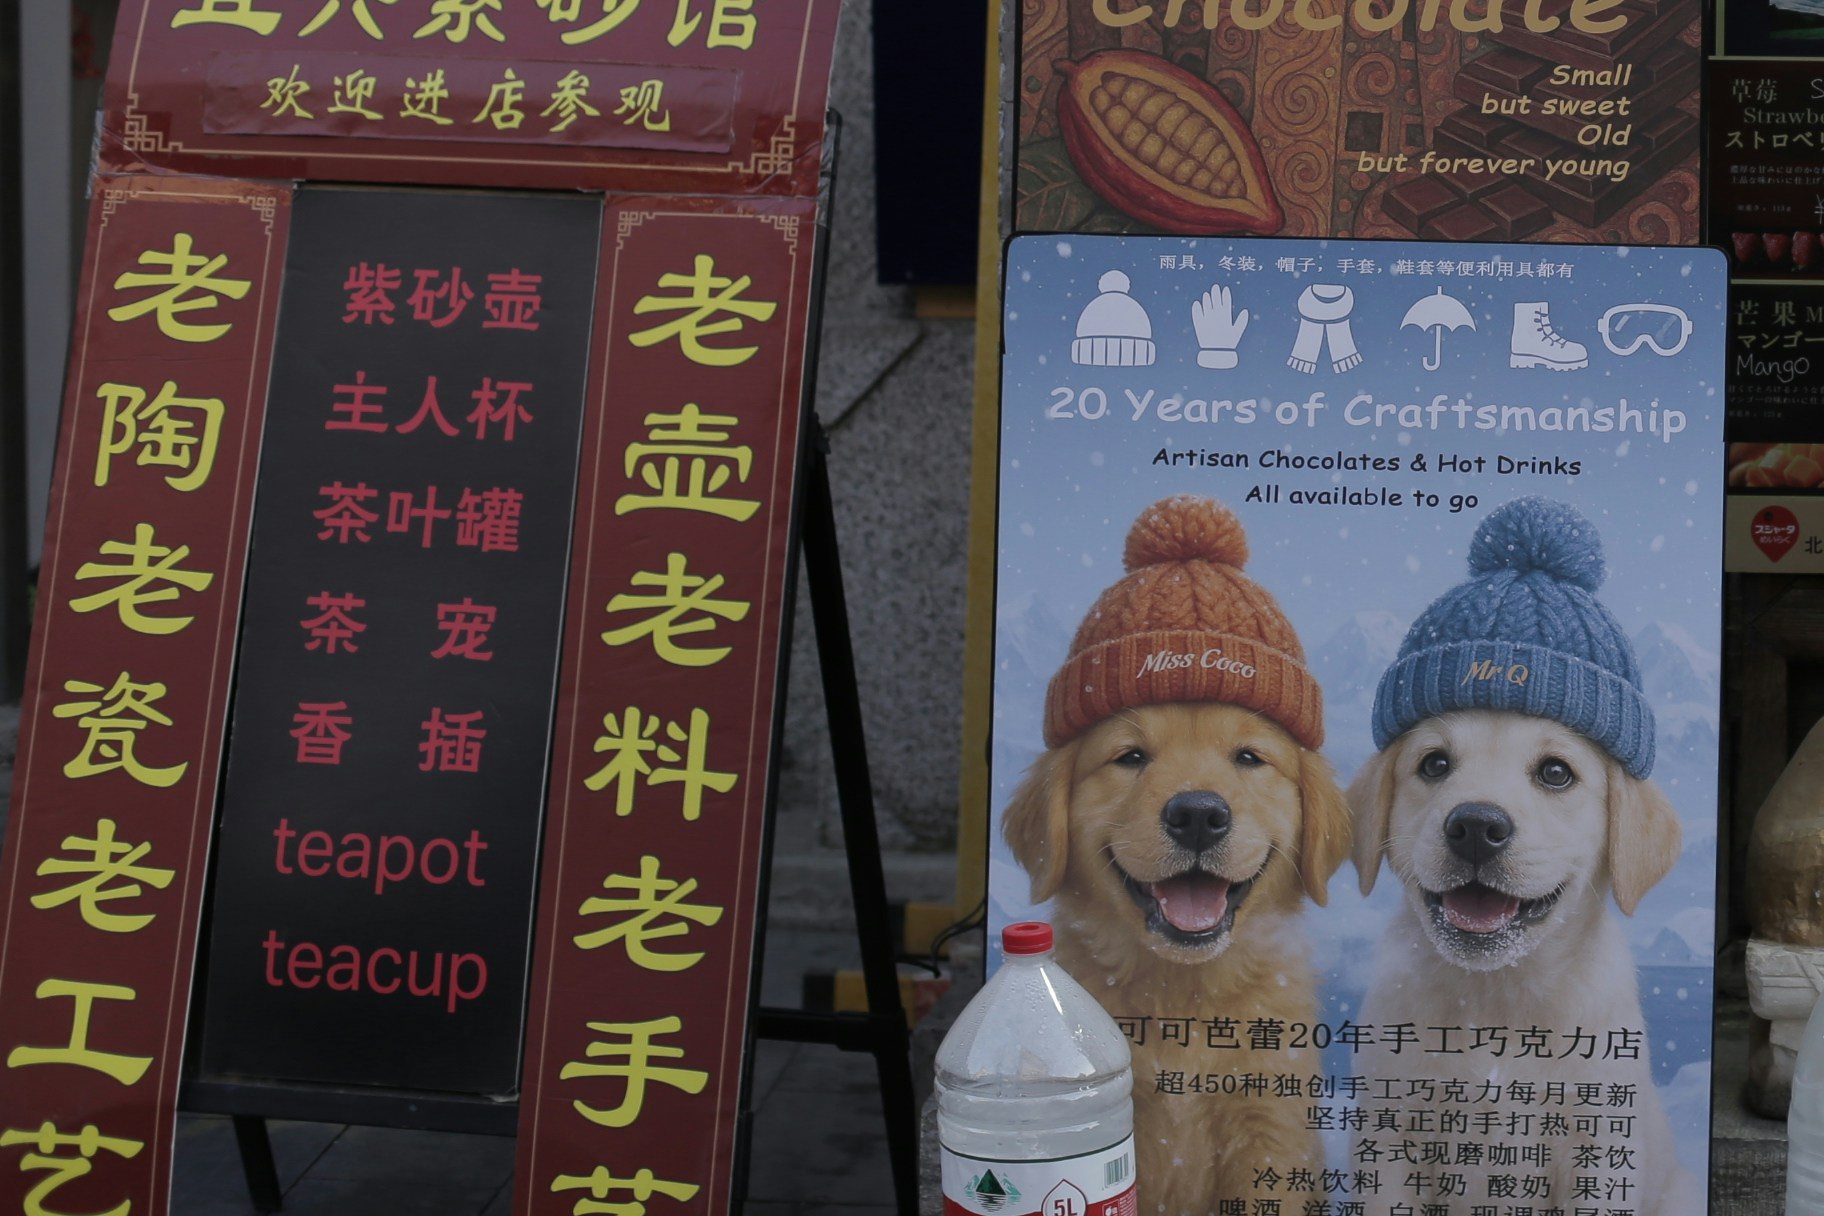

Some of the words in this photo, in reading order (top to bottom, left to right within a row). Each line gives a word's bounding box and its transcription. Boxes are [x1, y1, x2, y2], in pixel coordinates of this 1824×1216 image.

[1549, 63, 1634, 86] Small
[259, 64, 671, 133] 欢迎进店参观
[1480, 93, 1532, 115] but
[1540, 94, 1631, 116] sweet
[1732, 78, 1779, 105] 草莓
[1576, 123, 1631, 145] Old
[1357, 151, 1409, 174] but
[1420, 152, 1538, 175] forever
[1544, 155, 1631, 181] young
[341, 261, 543, 334] 紫砂壶
[1736, 354, 1810, 383] Mango
[324, 371, 535, 441] 主人杯
[1049, 385, 1108, 422] 20
[1128, 386, 1258, 427] Years
[1274, 389, 1325, 430] of
[1343, 392, 1688, 444] Craftsmanship
[1152, 447, 1250, 472] Artisan
[1258, 448, 1401, 474] Chocolates
[1410, 452, 1428, 473] &
[1437, 452, 1487, 475] Hot
[1495, 454, 1582, 477] Drinks
[1244, 484, 1281, 506] All
[1289, 485, 1404, 508] available
[1411, 488, 1441, 510] to
[1448, 491, 1480, 514] go
[312, 480, 525, 553] 茶叶罐
[1754, 525, 1796, 536] スジャータ
[1135, 649, 1197, 680] Miss
[1199, 648, 1257, 680] Coco
[1460, 660, 1502, 687] Mr
[1503, 660, 1530, 688] Q
[0, 233, 253, 1216] 老陶老瓷老工艺
[272, 817, 489, 895] teapot
[261, 928, 488, 1012] teacup
[1111, 1015, 1643, 1062] 可可芭蕾20年手工巧克力店
[1154, 1068, 1638, 1110] 超450种独创手工巧克力每月更新
[1305, 1106, 1638, 1138] 坚持真正的手打热可可
[1353, 1138, 1553, 1168] 各式现磨咖啡
[1571, 1142, 1637, 1171] 茶饮
[1252, 1166, 1383, 1195] 冷热饮料
[1402, 1169, 1467, 1196] 牛奶
[1486, 1173, 1552, 1199] 酸奶
[1572, 1174, 1636, 1202] 果汁
